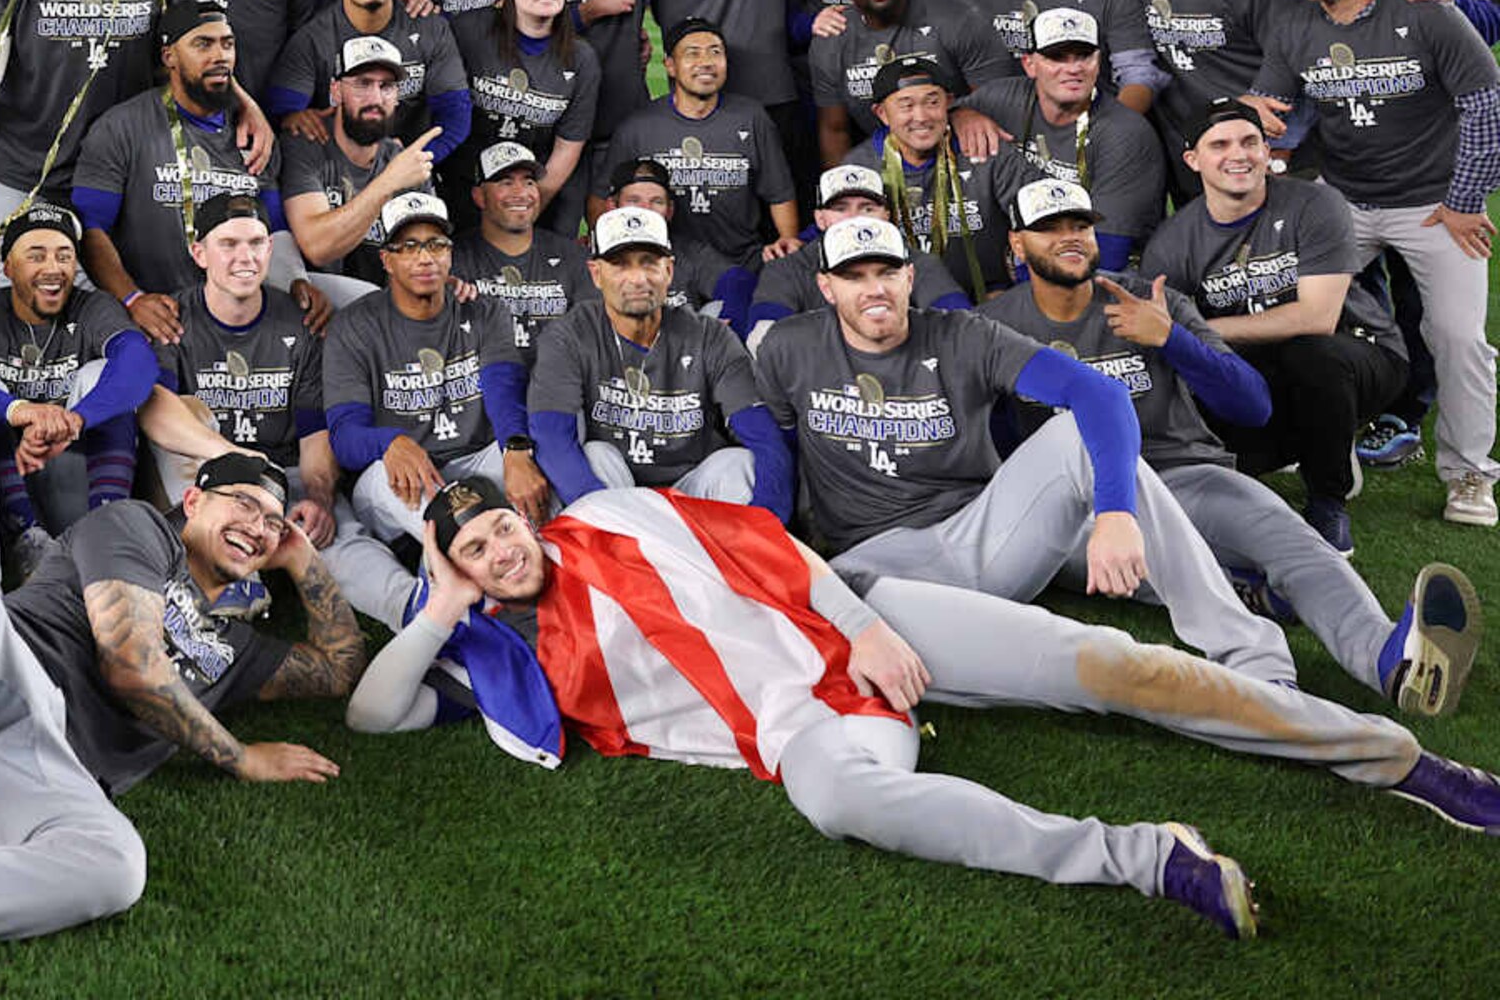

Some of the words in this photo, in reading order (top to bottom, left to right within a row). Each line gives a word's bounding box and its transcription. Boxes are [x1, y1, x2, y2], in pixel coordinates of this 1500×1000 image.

[38, 1, 98, 18] WORLD
[99, 1, 152, 17] SERIES
[1170, 17, 1224, 31] SERIES
[1301, 68, 1352, 84] WORLD
[1352, 60, 1422, 80] SERIES
[473, 75, 523, 100] WORLD
[523, 92, 569, 112] SERIES
[1347, 98, 1376, 127] LA
[702, 156, 750, 172] SERIES
[208, 172, 258, 191] SERIES
[475, 279, 520, 298] WORLD
[520, 282, 566, 298] SERIES
[196, 373, 248, 391] WORLD
[383, 374, 482, 410] CHAMPION
[384, 371, 444, 391] WORLD
[647, 394, 700, 410] SERIES
[810, 393, 870, 418] WORLD
[883, 397, 951, 419] SERIES
[233, 409, 258, 443] LA
[432, 410, 460, 441] LA
[807, 409, 956, 443] CHAMPIONS
[627, 430, 654, 465] LA
[868, 441, 899, 477] LA
